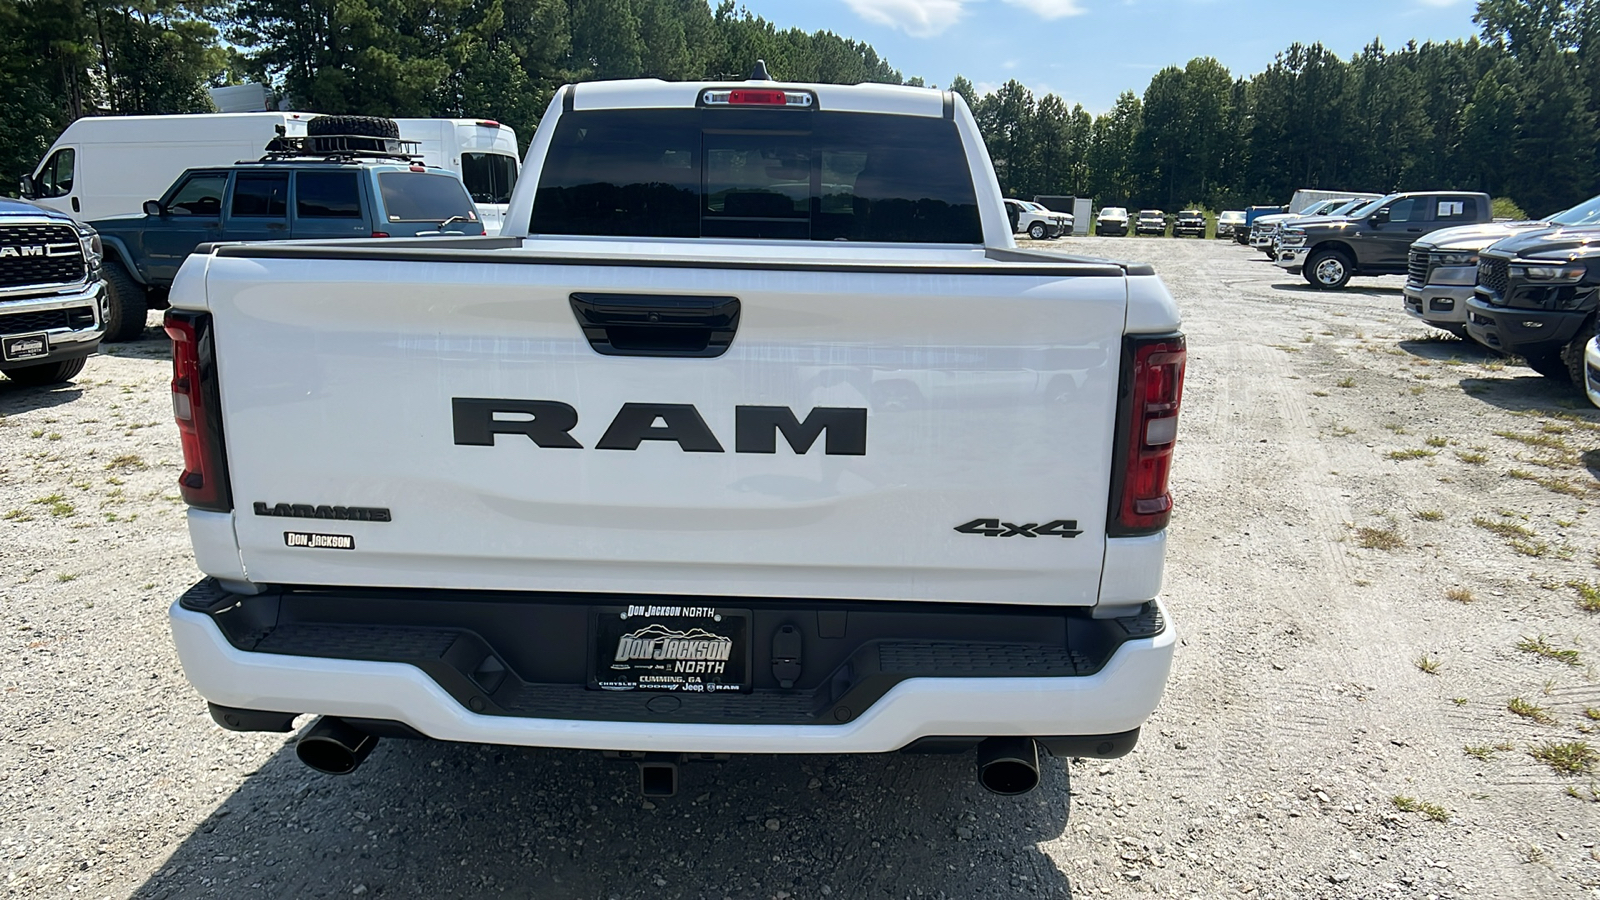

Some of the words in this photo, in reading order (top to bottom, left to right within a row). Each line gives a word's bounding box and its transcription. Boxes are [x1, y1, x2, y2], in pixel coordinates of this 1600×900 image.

[0, 246, 43, 257] AM
[452, 397, 868, 456] RAM
[253, 502, 392, 522] LARAMIE
[953, 518, 1084, 538] 4x4
[682, 606, 715, 618] NORTH
[674, 661, 725, 674] NORTH
[688, 676, 702, 684] GA
[682, 683, 704, 692] Jeep
